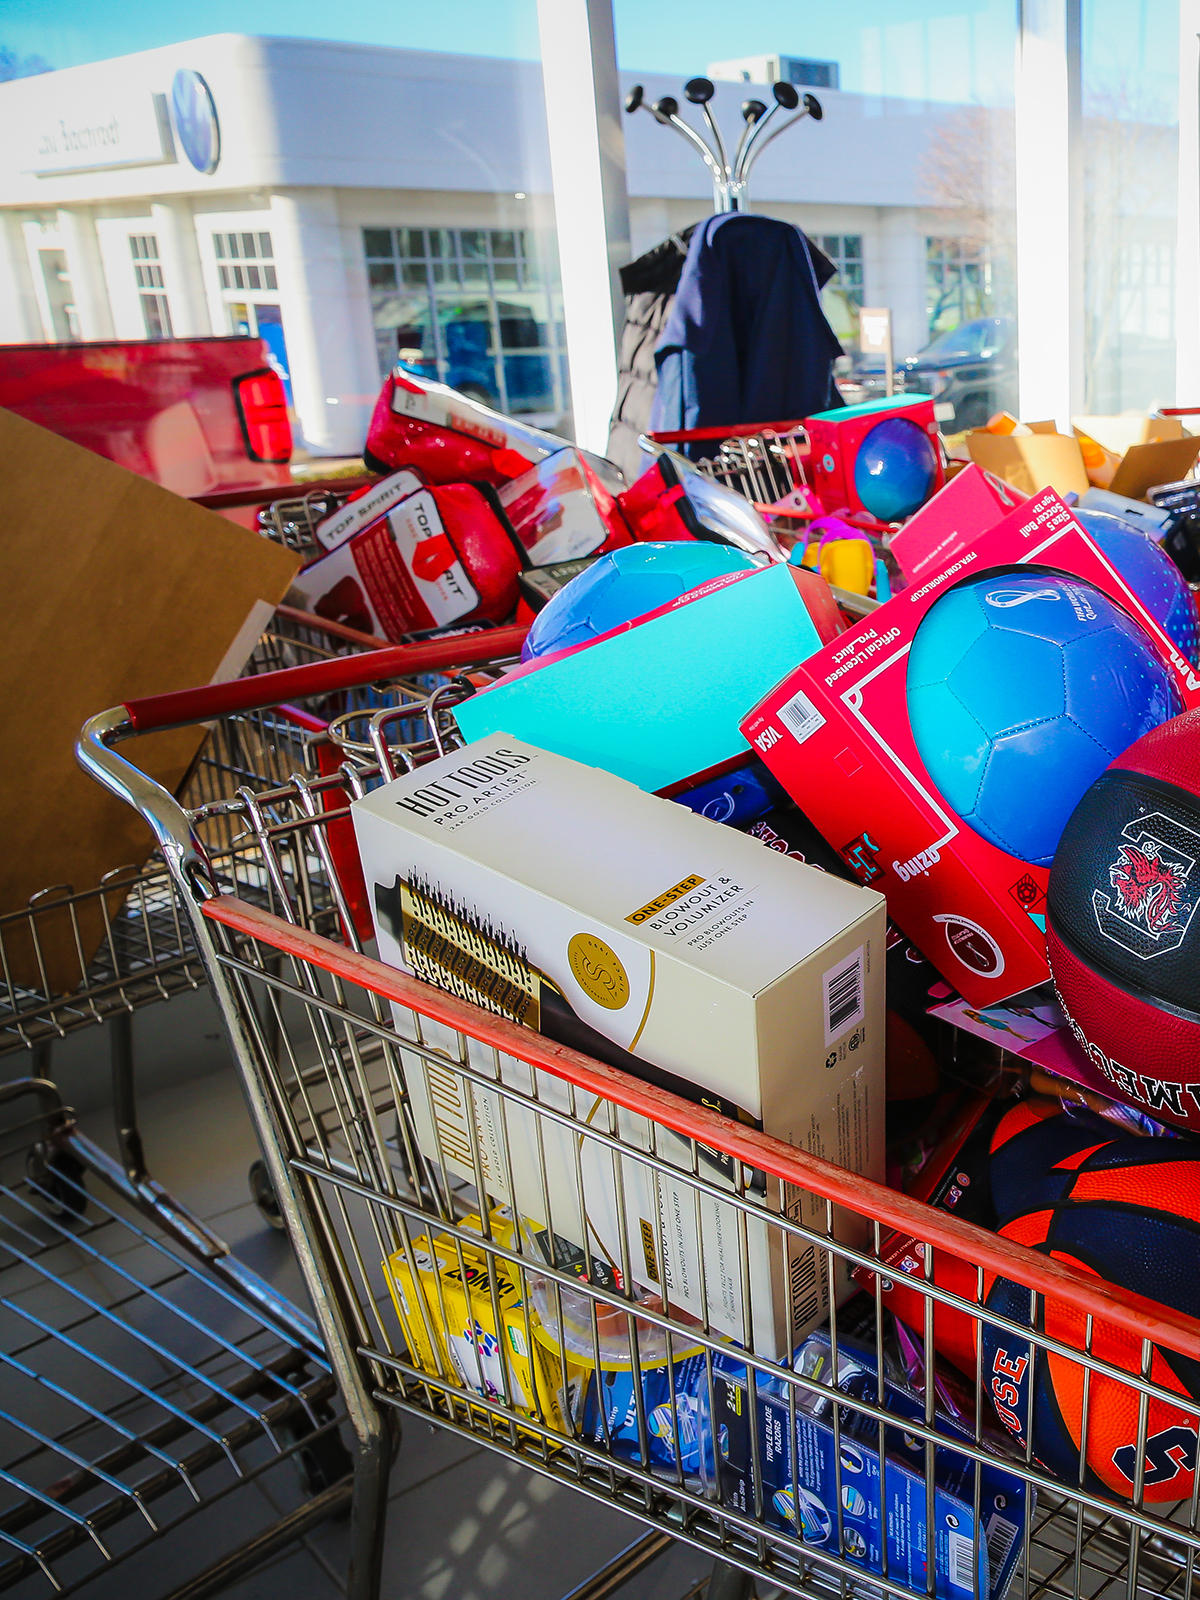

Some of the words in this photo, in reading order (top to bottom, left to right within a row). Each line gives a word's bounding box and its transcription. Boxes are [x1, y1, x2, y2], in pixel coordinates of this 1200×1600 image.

[326, 515, 355, 541] TOP
[356, 482, 403, 518] SPIRIT
[1037, 502, 1064, 528] Soccer
[1043, 493, 1056, 507] Age
[413, 502, 433, 538] TOP
[1019, 517, 1039, 539] Ball
[1048, 521, 1056, 532] 5
[1054, 509, 1071, 525] Size
[869, 626, 901, 658] Official
[824, 648, 869, 688] Licensed
[753, 725, 784, 753] VISA
[395, 780, 438, 818] HOT
[442, 748, 531, 799] TOOLS
[433, 803, 469, 826] PRO
[449, 819, 466, 831] 24K
[467, 805, 489, 821] GOLD
[490, 779, 537, 807] COLLECTION
[632, 878, 697, 921] ONE-STEP
[649, 883, 718, 931] BLOWOUT
[718, 876, 732, 885] &
[663, 884, 744, 937] VOLUMIZER
[687, 934, 704, 947] PRO
[703, 906, 745, 936] BLOWOUTS
[743, 899, 755, 908] IN
[697, 937, 715, 952] JUST
[714, 925, 733, 939] ONE
[731, 913, 749, 928] STEP
[672, 1191, 680, 1207] STEP
[674, 1208, 682, 1224] ONE
[676, 1224, 684, 1241] JUST
[642, 1221, 659, 1281] ONE-STEP
[679, 1251, 691, 1286] BLOWOUTS
[791, 1245, 816, 1300] TOOLS
[683, 1286, 692, 1300] PRO
[820, 1284, 830, 1308] PRO
[795, 1292, 819, 1332] HOT
[725, 1381, 736, 1413] 2+1
[764, 1405, 774, 1433] BLADE
[766, 1433, 774, 1463] TRIPLE
[773, 1419, 783, 1455] RAZORS
[738, 1479, 746, 1496] Strip
